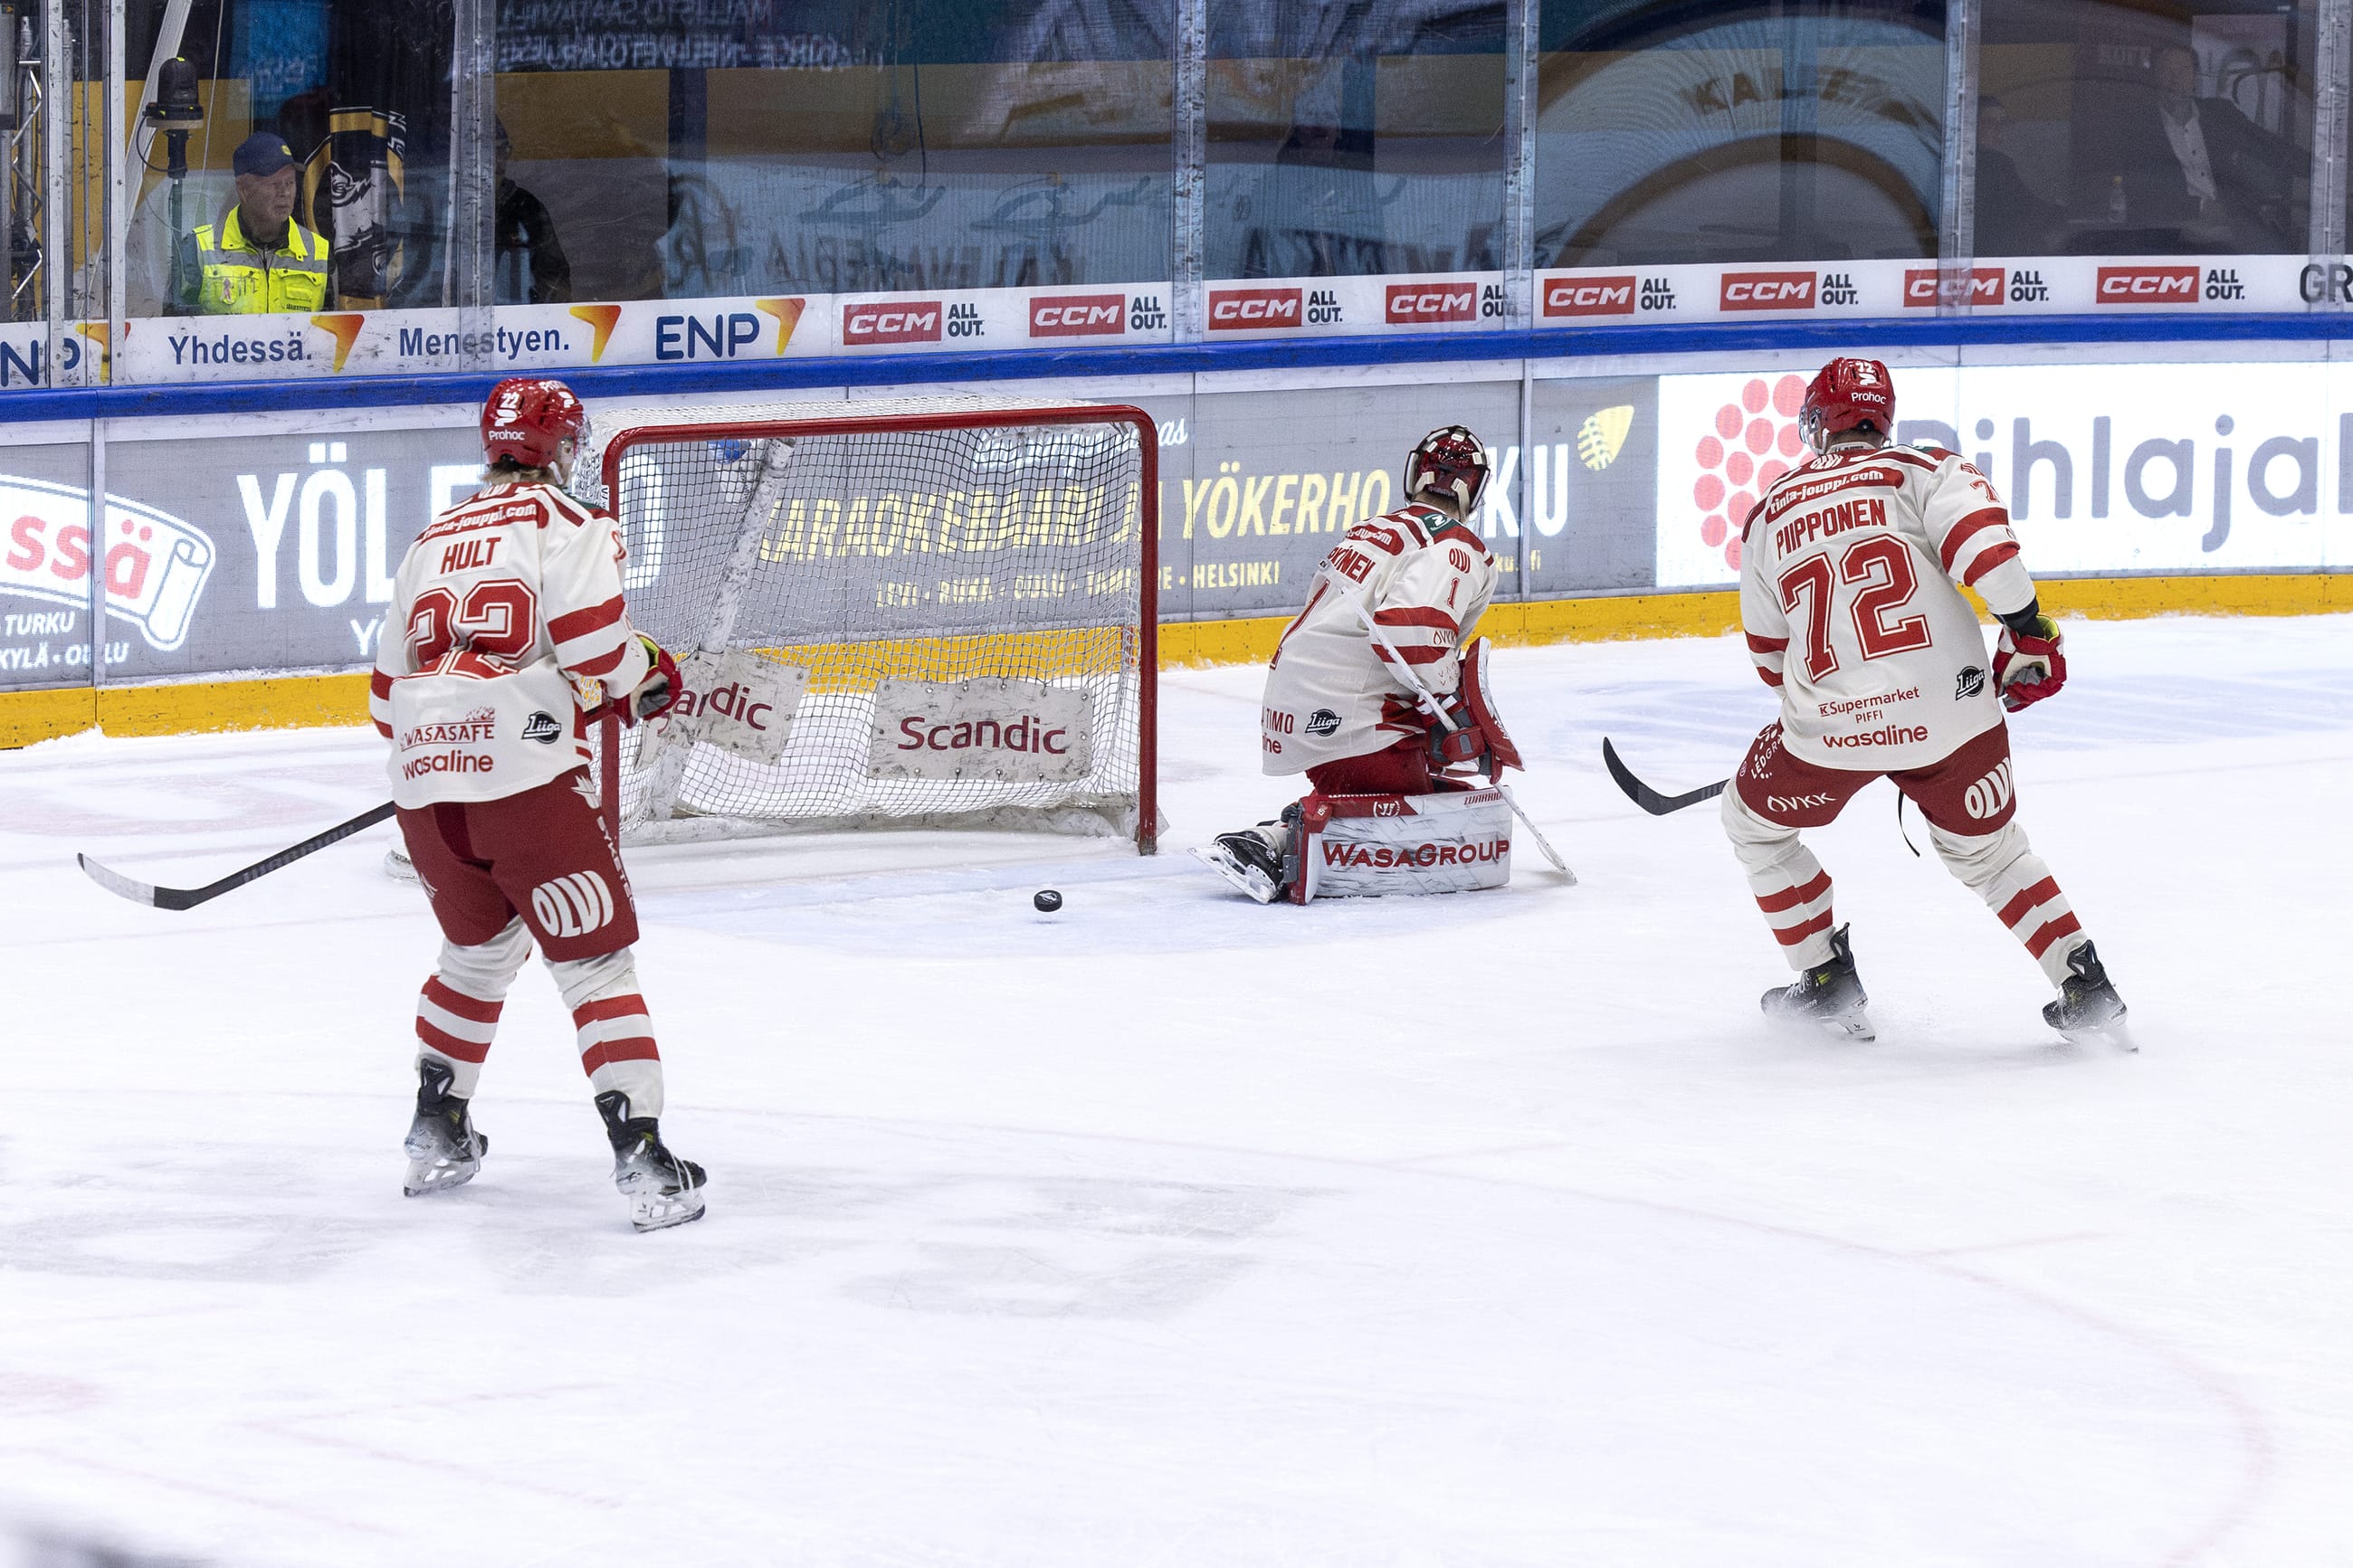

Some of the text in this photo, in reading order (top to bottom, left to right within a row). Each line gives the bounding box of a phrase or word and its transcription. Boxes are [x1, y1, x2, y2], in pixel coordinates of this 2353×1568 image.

[1642, 277, 1671, 293] ALL
[1823, 273, 1853, 290] ALL
[2011, 271, 2043, 285] ALL
[2101, 274, 2194, 295] CCM
[2207, 269, 2239, 285] ALL
[1309, 290, 1338, 306] ALL
[1481, 285, 1504, 299] AL
[1548, 287, 1631, 307] CCM
[1725, 281, 1811, 301] CCM
[1821, 290, 1859, 305] OUT.
[2010, 287, 2049, 301] OUT.
[2205, 285, 2245, 300] OUT.
[948, 303, 978, 318] ALL
[1131, 297, 1159, 312] ALL
[1214, 299, 1299, 320] CCM
[1390, 293, 1472, 315] CCM
[1641, 294, 1677, 310] OUT.
[848, 310, 938, 335] CCM
[1034, 305, 1122, 328] CCM
[1131, 313, 1167, 330] OUT.
[1307, 307, 1343, 323] OUT.
[656, 312, 760, 360] ENP
[947, 320, 985, 337] OUT.
[168, 331, 312, 365] Yhdessä.
[399, 326, 569, 361] Menestyen.
[500, 391, 520, 409] 22
[1851, 391, 1887, 404] Prohoc
[488, 429, 526, 442] Prohoc
[1182, 461, 1391, 539] YÖKERHO
[1776, 499, 1887, 561] PIIPPONEN
[440, 537, 502, 575] HULT
[1193, 560, 1280, 589] HELSINKI
[1777, 533, 1933, 685] 72
[5, 610, 76, 637] TURKU
[1855, 709, 1883, 724] PIFFI
[897, 716, 1067, 755] Scandic
[1823, 725, 1929, 748] wasaline
[403, 749, 493, 781] wasaline
[531, 870, 614, 937] OLVI
